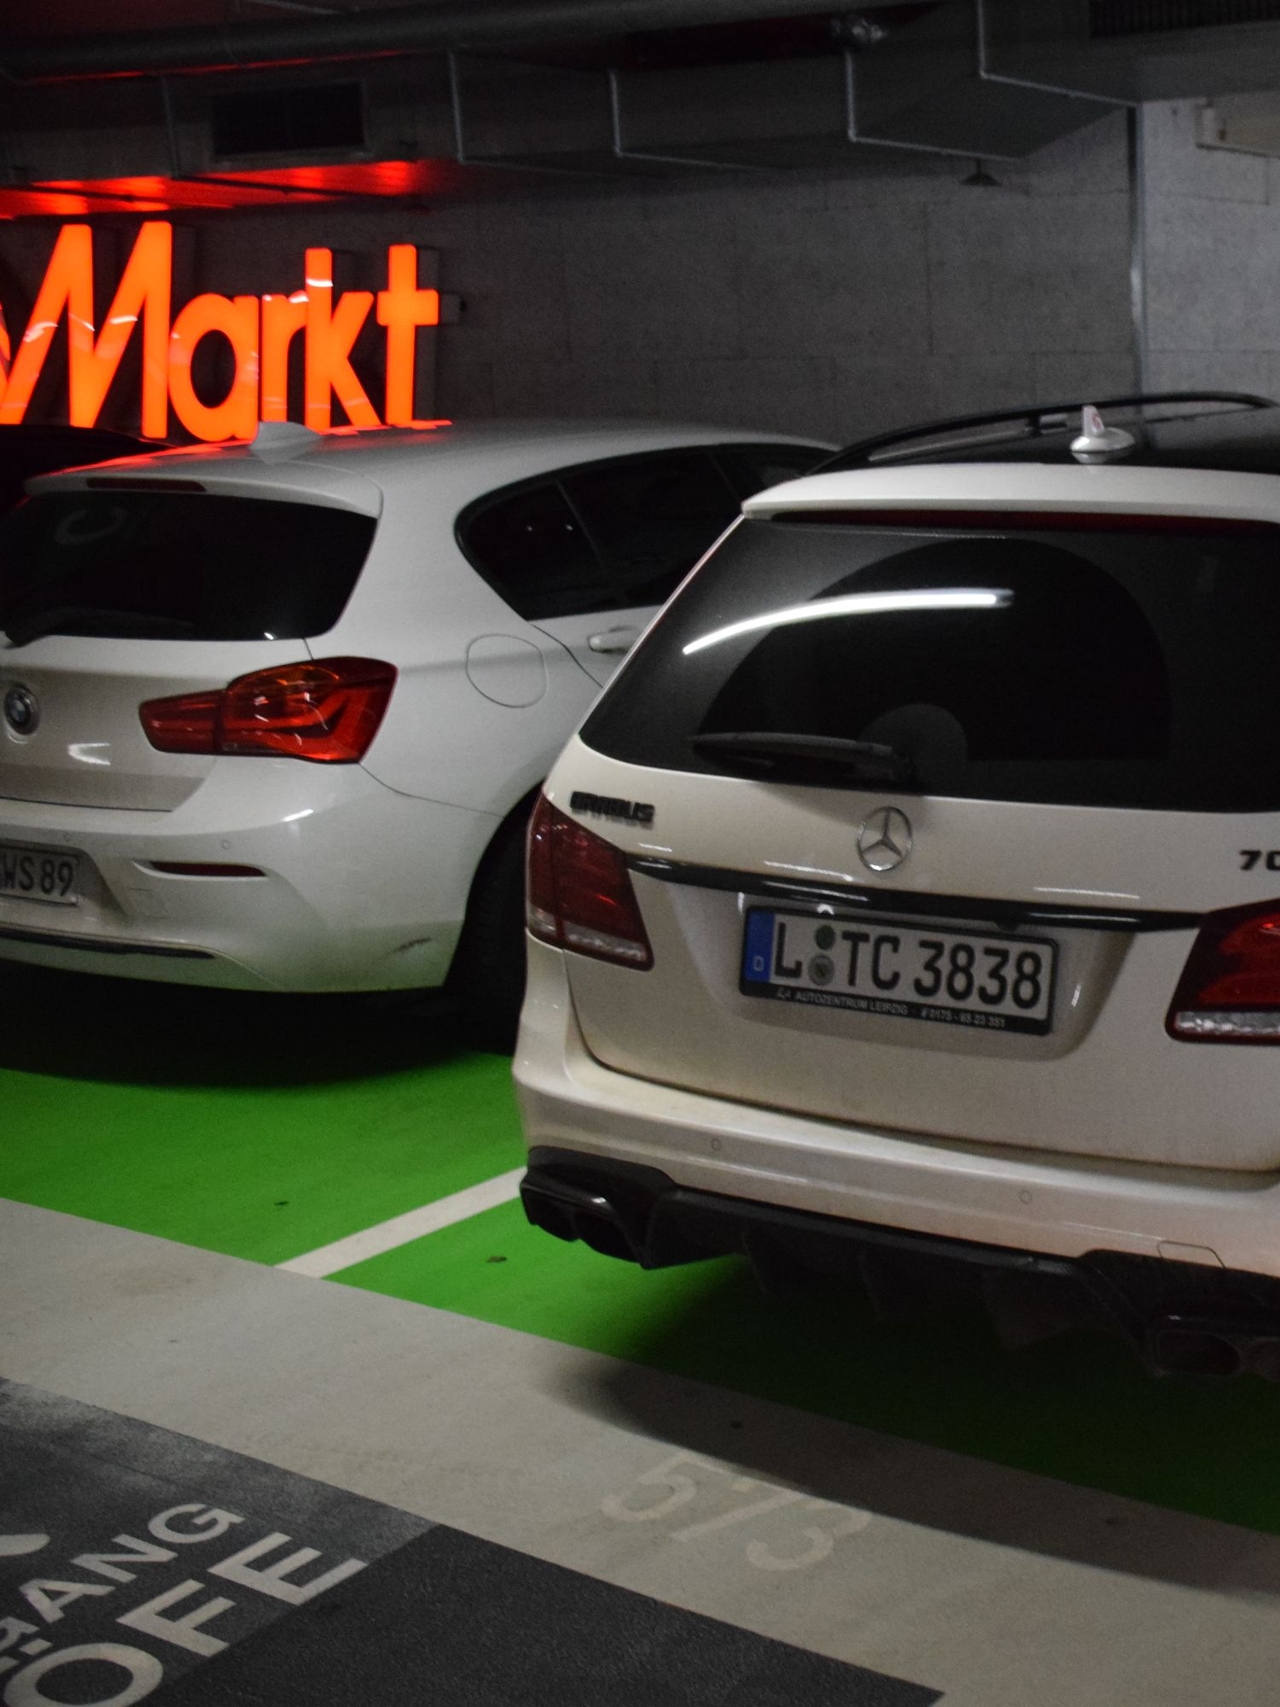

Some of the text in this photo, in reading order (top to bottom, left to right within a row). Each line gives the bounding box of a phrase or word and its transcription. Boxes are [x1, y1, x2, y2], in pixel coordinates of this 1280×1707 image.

[41, 858, 74, 897] 89
[774, 922, 1042, 1009] L TC 3838
[796, 990, 868, 1010] AUTOZENTRUM
[870, 1001, 908, 1016] LEIPZIG
